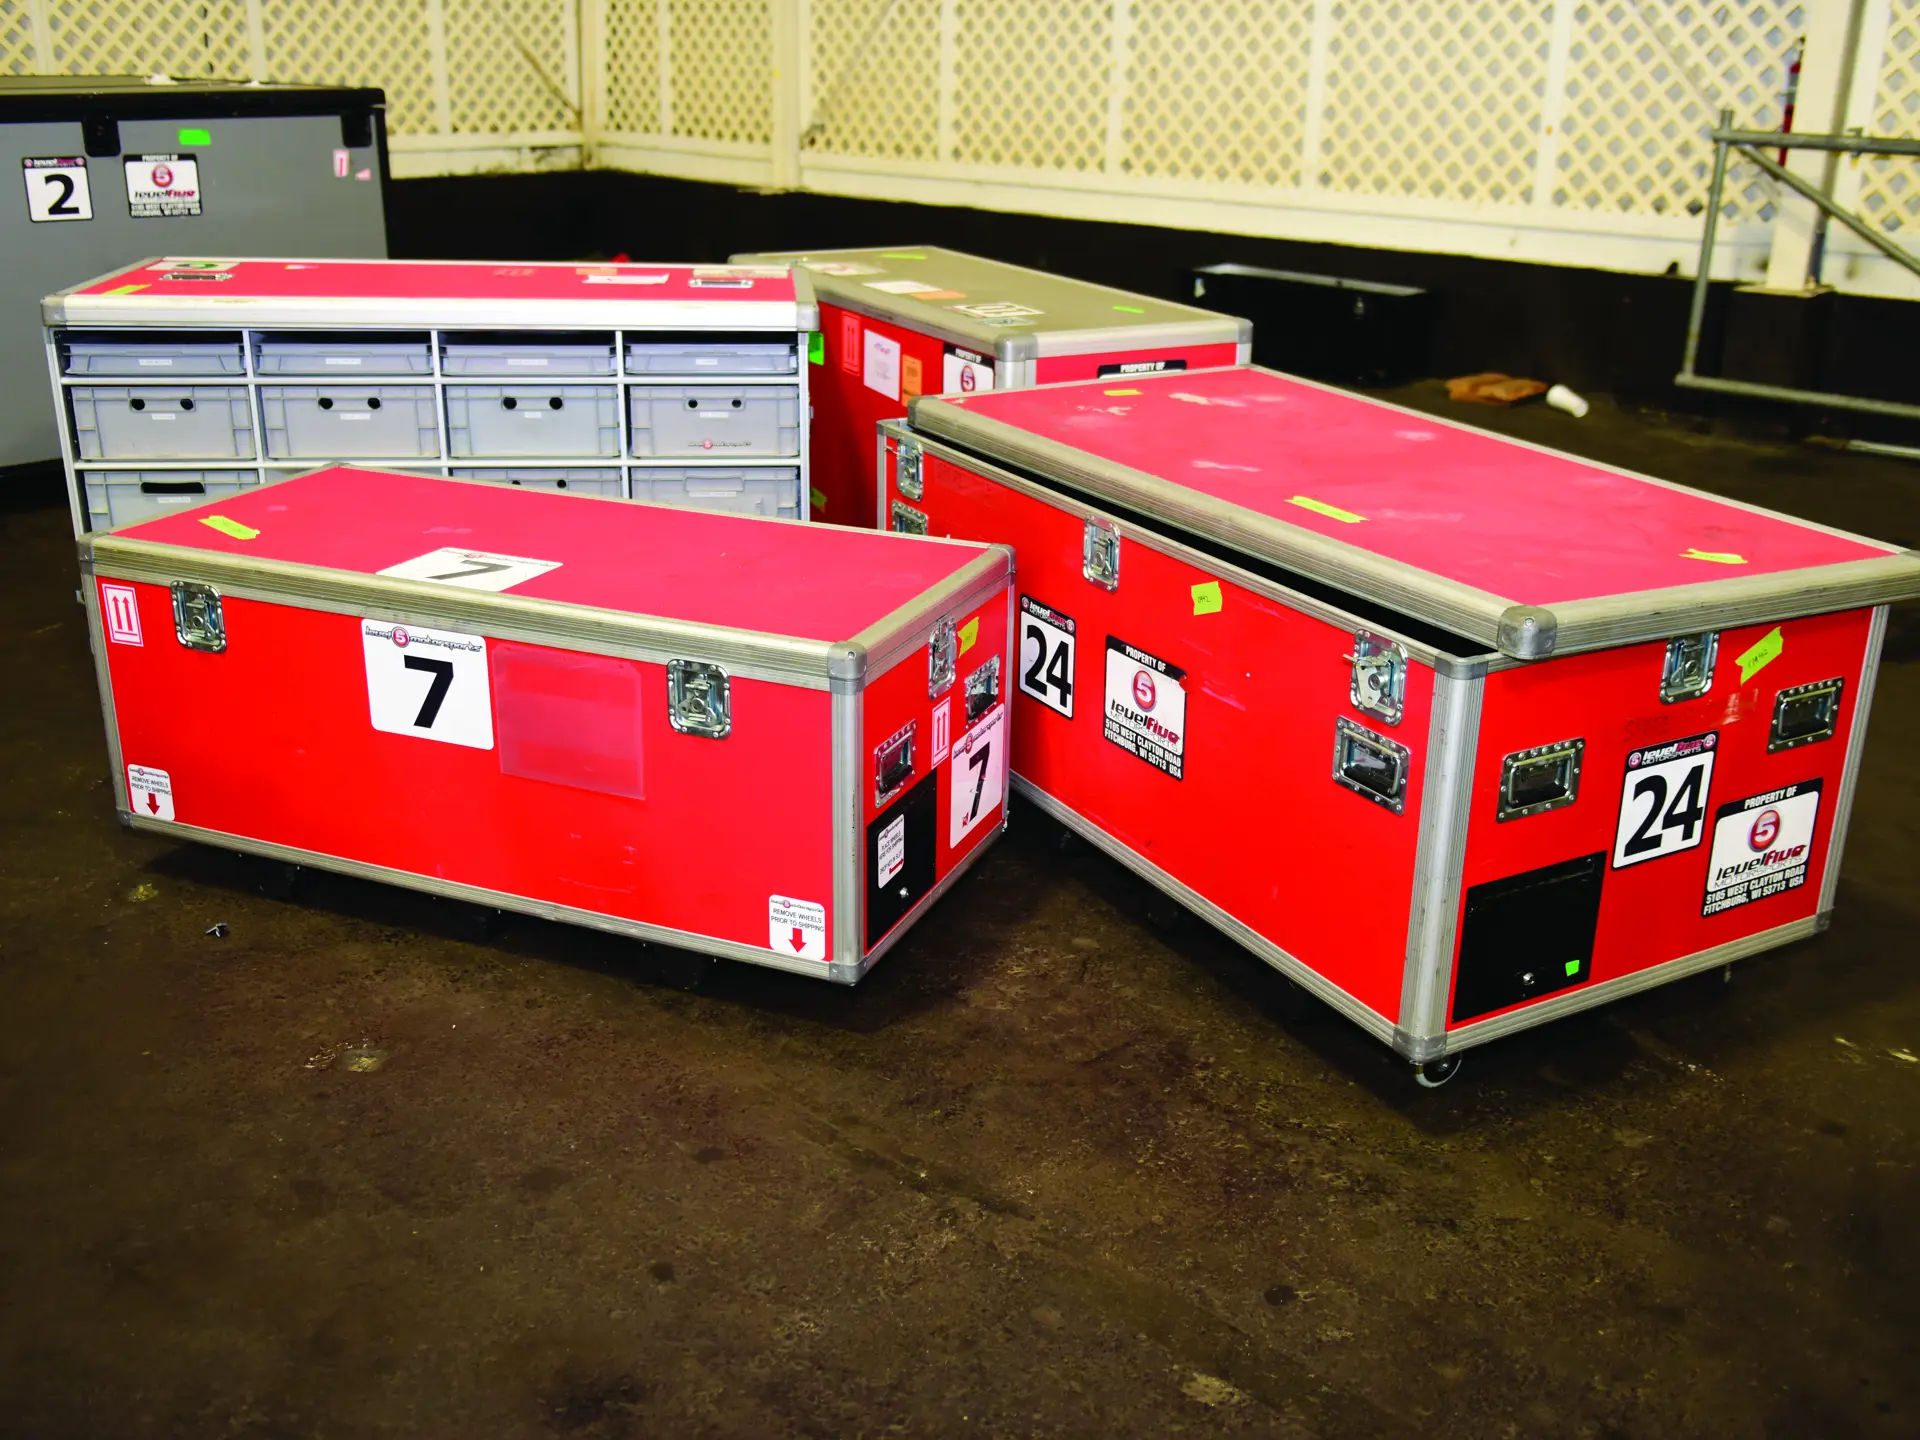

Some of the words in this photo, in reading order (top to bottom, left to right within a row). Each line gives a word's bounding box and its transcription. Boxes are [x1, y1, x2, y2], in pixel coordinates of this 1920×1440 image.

[44, 174, 79, 215] 2
[962, 369, 974, 391] 5
[1120, 362, 1155, 374] PROPERTY
[1156, 362, 1166, 370] OF
[425, 559, 513, 580] 7
[393, 628, 408, 646] 5
[409, 634, 483, 652] motorsports
[1025, 624, 1072, 708] 24
[1126, 646, 1157, 668] PROPERTY
[1158, 661, 1166, 672] OF
[404, 655, 454, 728] 7
[1135, 673, 1154, 706] 5
[1106, 718, 1120, 734] 5105
[1120, 726, 1136, 742] WEST
[1138, 736, 1164, 758] CLAYTON
[1164, 750, 1181, 767] ROAD
[1110, 711, 1178, 752] MOTORSPORTS
[1104, 728, 1138, 756] FITCHBURG,
[1139, 747, 1148, 760] WI
[1148, 752, 1166, 770] 53713
[1169, 763, 1182, 779] USA
[1642, 747, 1702, 765] MOTORSPORTS
[132, 776, 150, 784] REMOVE
[150, 780, 168, 788] WHEELS
[969, 741, 990, 822] 7
[1744, 789, 1786, 810] PROPERTY
[1786, 786, 1798, 797] OF
[1624, 764, 1704, 858] 24
[1753, 812, 1778, 846] 5
[1706, 890, 1726, 904] 5105
[1726, 882, 1748, 898] WEST
[1750, 872, 1784, 891] CLAYTON
[1784, 864, 1806, 878] ROAD
[1714, 858, 1802, 888] MOTORSPORTS
[1703, 894, 1748, 916] FITCHBURG,
[1751, 889, 1762, 900] WI
[1762, 881, 1786, 896] 53713
[1788, 876, 1804, 888] USA
[771, 915, 788, 924] PRIOR
[798, 921, 824, 932] SHIPPING
[773, 907, 797, 918] REMOVE
[798, 912, 822, 924] WHEELS
